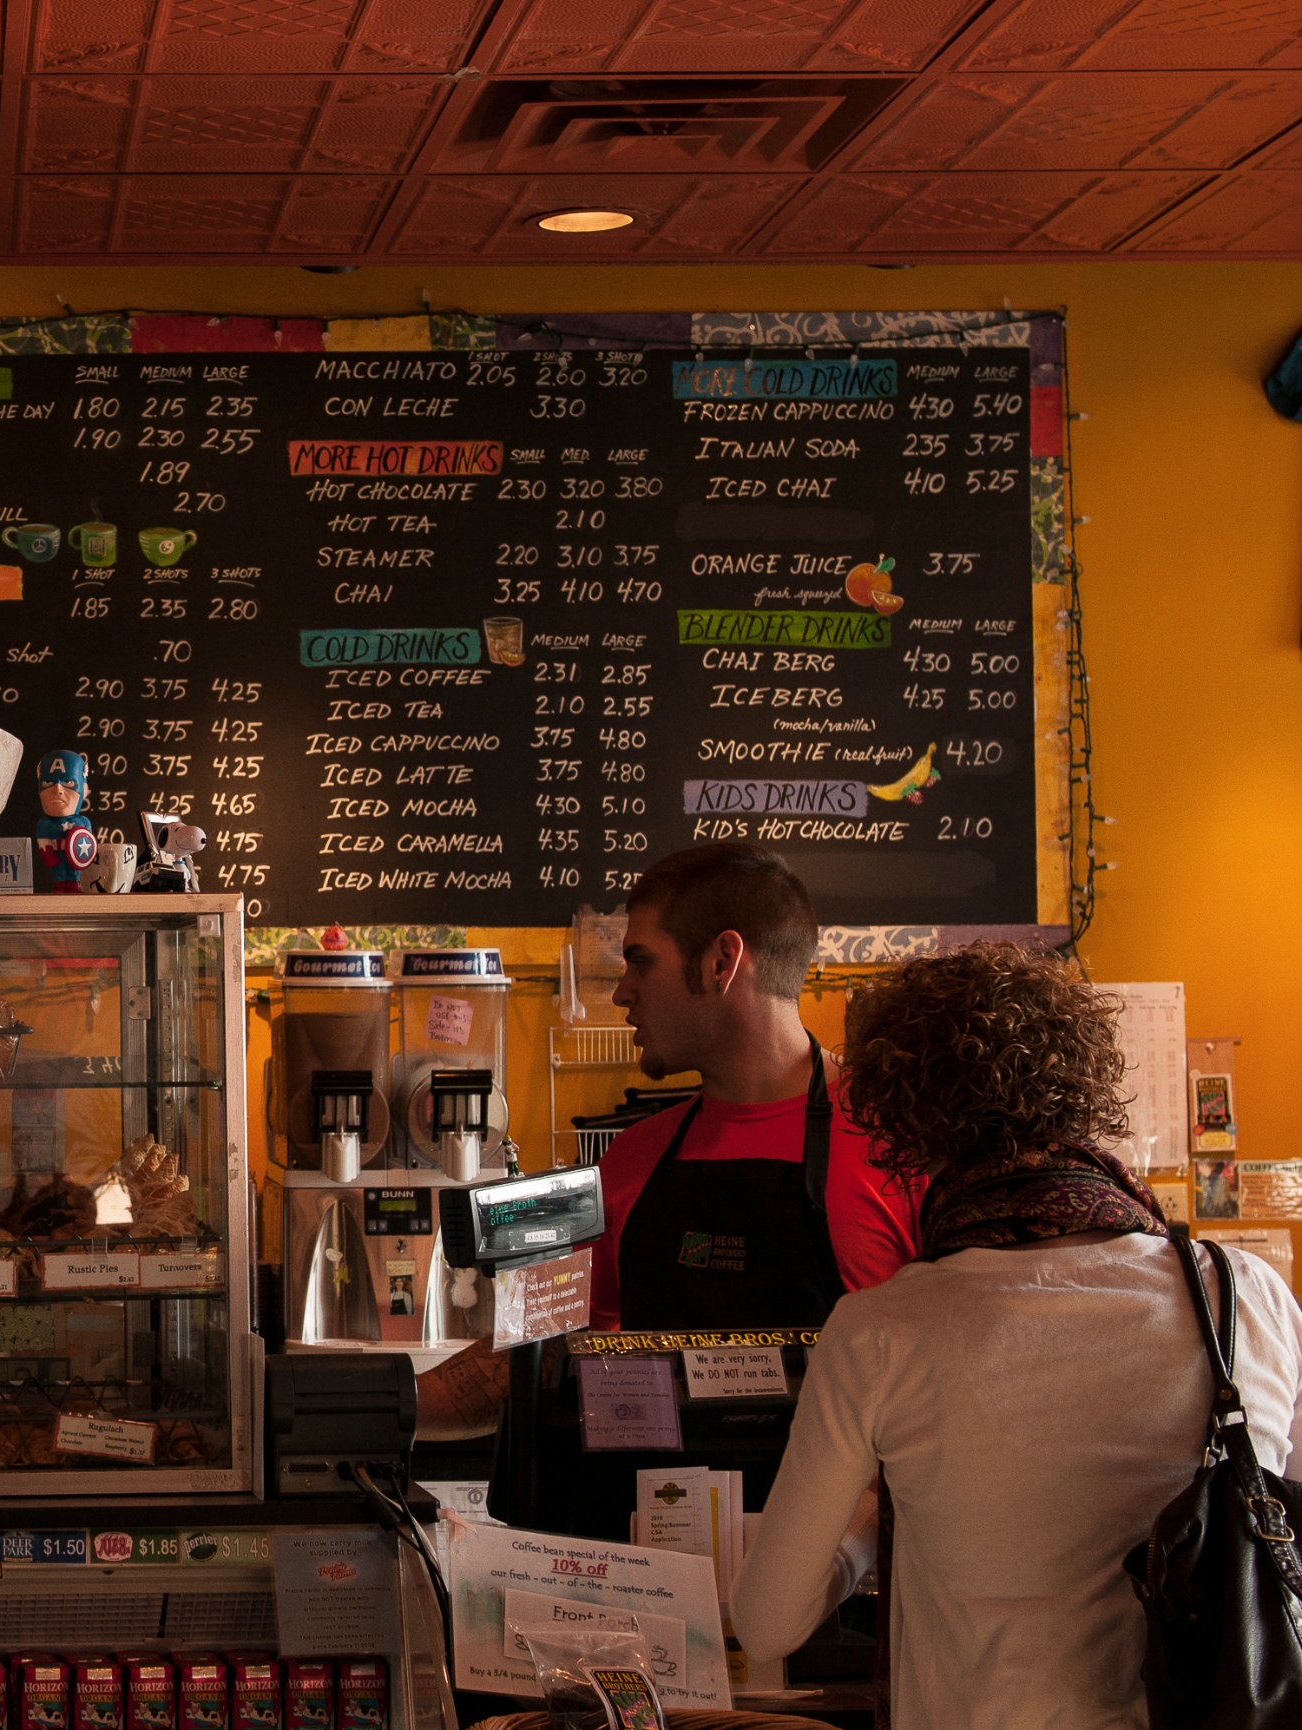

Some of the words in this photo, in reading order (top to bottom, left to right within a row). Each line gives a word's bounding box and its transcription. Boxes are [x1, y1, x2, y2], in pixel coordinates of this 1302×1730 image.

[314, 360, 456, 381] MACCHIATO
[676, 366, 736, 396] MORE
[745, 366, 803, 396] COLD
[809, 366, 894, 396] DRINKS
[23, 403, 55, 419] DAY
[73, 398, 119, 419] 1.80
[141, 399, 186, 417] 2.15
[206, 397, 258, 417] 2.35
[684, 401, 768, 422] FROZEN
[774, 401, 895, 421] CAPPUCCINO
[909, 393, 954, 419] 4.30
[972, 393, 1022, 417] 5.40
[73, 429, 120, 448] 1.90
[138, 429, 185, 448] 2.30
[201, 429, 259, 454] 2.55
[695, 437, 795, 460] ITALIAN
[806, 438, 860, 459] SODA
[294, 444, 361, 472] MORE
[367, 445, 414, 472] HOT
[418, 444, 498, 472] DRINKS
[306, 479, 355, 501] HOT
[358, 483, 479, 501] CHOCOLATE
[498, 479, 546, 499] 2.30
[560, 480, 605, 499] 3.20
[614, 476, 663, 497] 3.80
[317, 548, 435, 567] STEAMER
[692, 553, 781, 575] ORANGE
[790, 555, 852, 575] JUICE
[923, 553, 980, 575] 3.75
[335, 583, 394, 603] CHAI
[494, 578, 541, 602] 3.25
[560, 578, 603, 602] 4.10
[617, 578, 662, 602] 4.70
[71, 599, 110, 618] 1.85
[141, 599, 188, 618] 2.35
[208, 599, 257, 620] 2.80
[684, 614, 794, 642] BLENDER
[803, 616, 889, 643] DRINKS
[308, 634, 369, 663] COLD
[375, 632, 471, 662] DRINKS
[531, 634, 590, 646] MEDIUM
[602, 634, 647, 646] LARGE
[702, 648, 764, 671] CHAI
[774, 652, 835, 673] BERG
[903, 645, 951, 673] 4.30
[970, 651, 1020, 675] 5.00
[75, 677, 124, 699] 2.90
[141, 678, 189, 699] 3.75
[212, 678, 263, 702] 4.25
[306, 734, 361, 754] ICED
[370, 733, 500, 752] CAPPUCCINO
[530, 727, 575, 748] 3.75
[600, 728, 646, 749] 4.80
[698, 738, 831, 761] SMOOTHIE
[696, 783, 760, 812] KIDS
[764, 782, 857, 812] DRINKS
[758, 819, 798, 840] HOT
[800, 822, 909, 841] CHOCOLATE
[938, 816, 993, 840] 2.10
[318, 868, 372, 891] ICED
[379, 868, 438, 889] WHITE
[445, 871, 512, 889] MOCHA
[68, 1265, 97, 1274] Rustic
[100, 1264, 118, 1273] Pies
[158, 1263, 201, 1272] Turnovers
[593, 1335, 656, 1350] DRINK
[696, 1355, 708, 1363] We
[729, 1355, 744, 1365] very
[692, 1370, 704, 1379] We
[709, 1370, 720, 1379] DO
[724, 1370, 738, 1378] NOT
[761, 1368, 780, 1377] tabs.
[89, 1423, 123, 1433] Rugulach
[4, 1537, 34, 1546] DEER
[5, 1545, 33, 1557] PARK
[43, 1538, 84, 1555] $1.50
[139, 1538, 178, 1555] $1.85
[512, 1542, 541, 1552] Coffee
[544, 1545, 564, 1556] bean
[567, 1548, 596, 1560] special
[599, 1551, 609, 1560] of
[611, 1554, 626, 1563] the
[628, 1556, 650, 1566] week
[552, 1559, 581, 1573] 10%
[588, 1563, 608, 1576] off
